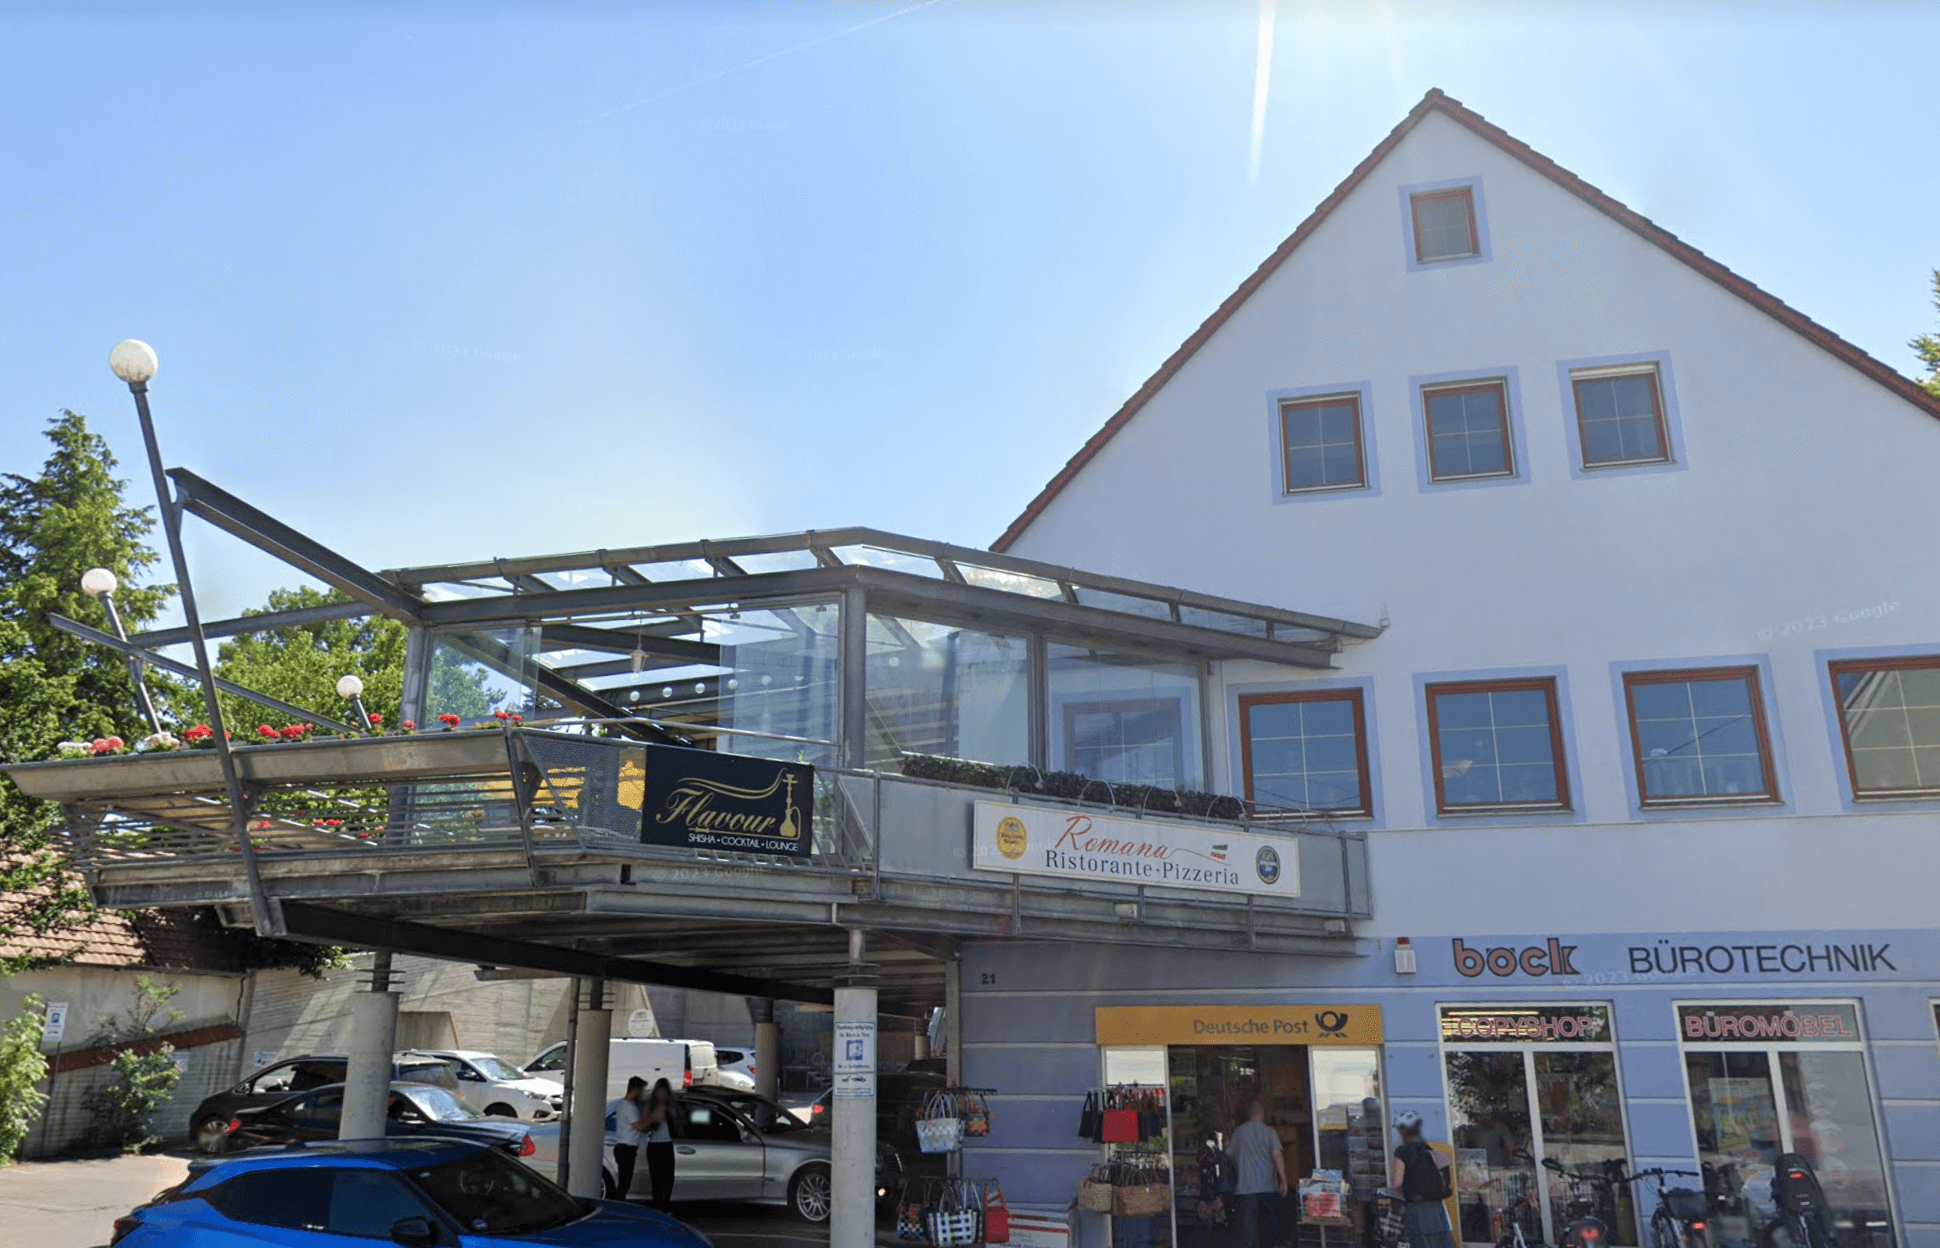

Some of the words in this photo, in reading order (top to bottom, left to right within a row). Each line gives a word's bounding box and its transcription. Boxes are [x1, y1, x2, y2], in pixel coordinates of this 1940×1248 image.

[655, 788, 777, 834] Flavour
[688, 833, 716, 844] SHISHA
[721, 836, 761, 849] COCKTAIL
[765, 840, 799, 852] LOUNGE
[1055, 814, 1172, 860] Romana
[1045, 850, 1152, 878] Ristorante
[1162, 861, 1240, 885] Pizzeria
[1628, 938, 1897, 974] BÜROTECHNIK
[981, 972, 997, 985] 21
[1193, 1019, 1269, 1034] Deutsche
[1273, 1019, 1309, 1034] Post
[1457, 1015, 1594, 1038] COPYSHOP
[1685, 1010, 1852, 1038] BÜROMÖBEL
